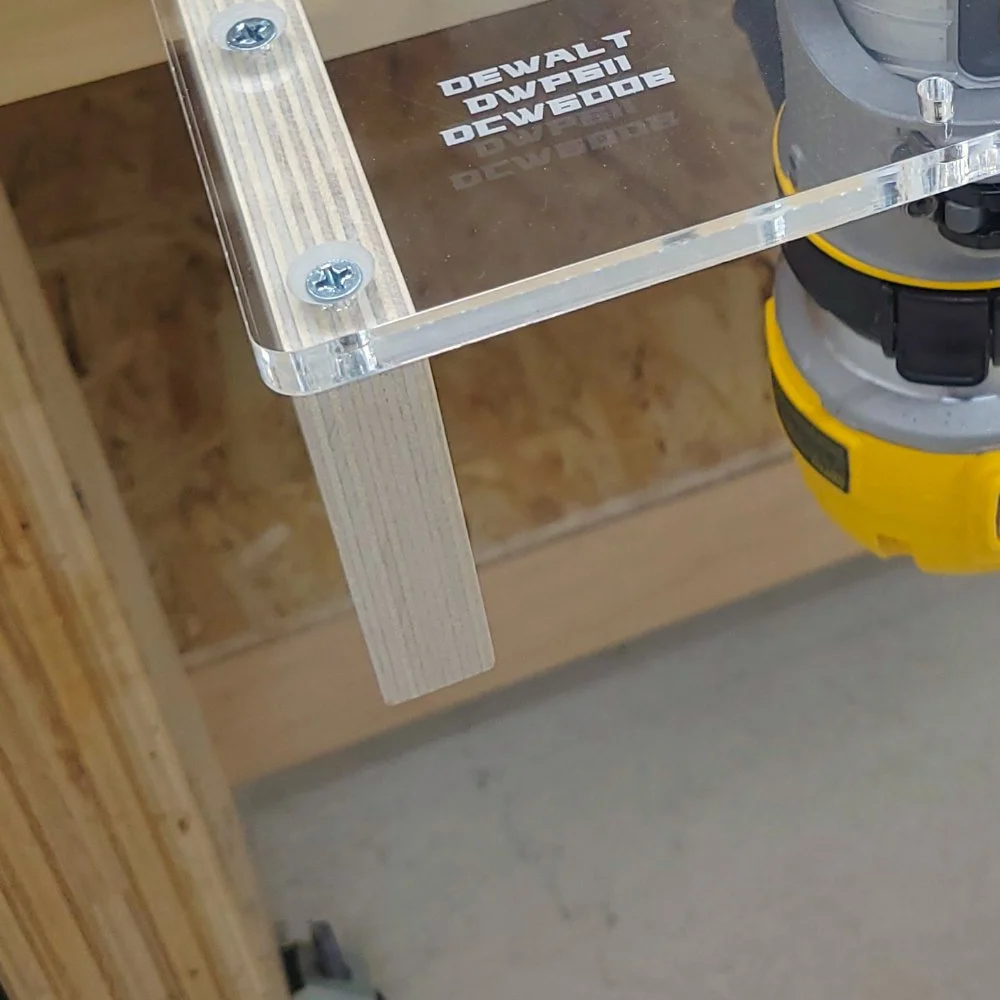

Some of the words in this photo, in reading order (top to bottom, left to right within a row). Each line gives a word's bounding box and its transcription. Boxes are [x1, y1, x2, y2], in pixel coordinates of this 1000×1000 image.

[437, 29, 632, 97] DEWALT
[462, 54, 632, 115] DWP611
[439, 66, 676, 147] DCW600B
